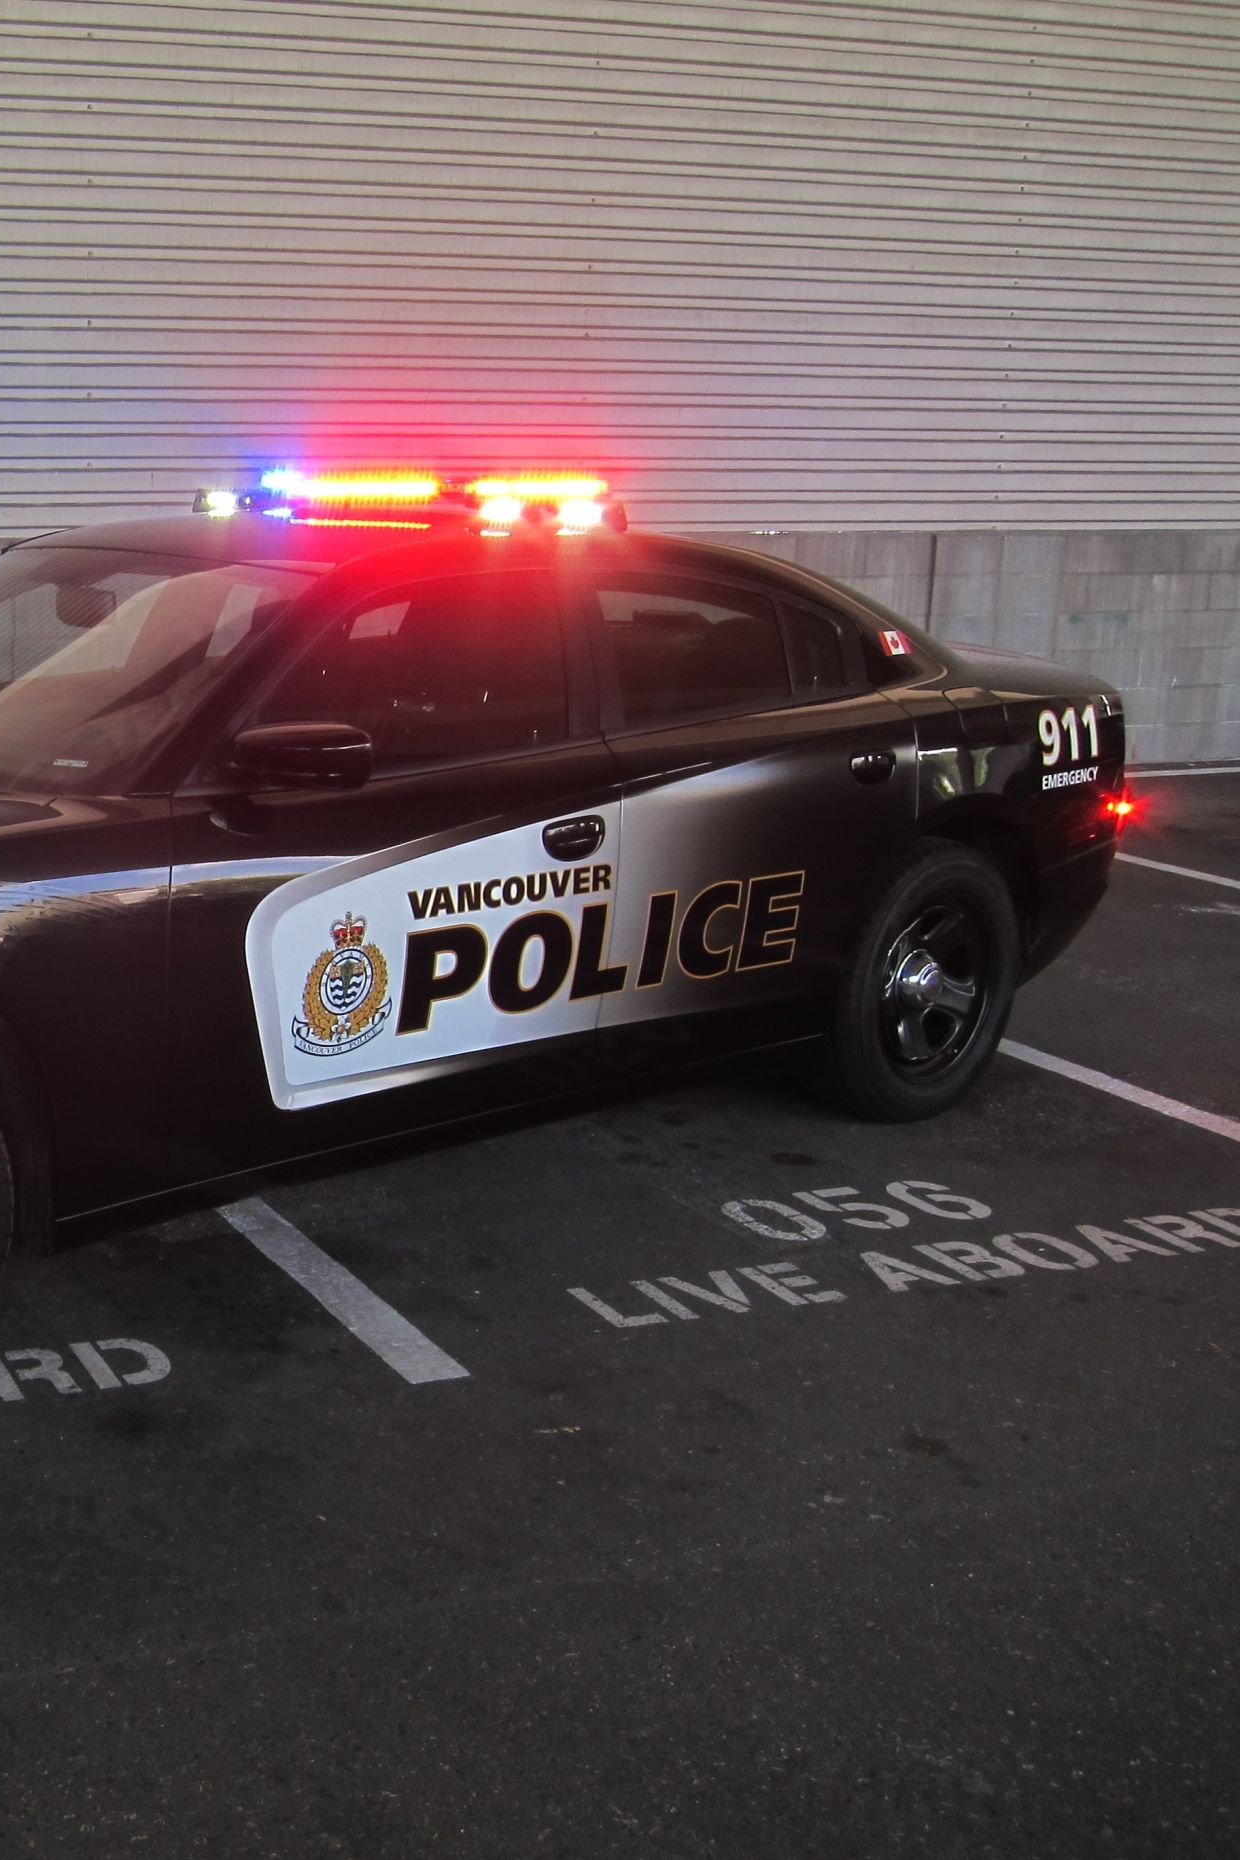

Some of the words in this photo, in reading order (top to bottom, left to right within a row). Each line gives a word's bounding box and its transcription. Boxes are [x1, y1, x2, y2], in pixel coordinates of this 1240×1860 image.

[1037, 704, 1100, 767] 911
[1041, 766, 1099, 791] EMERGENCY
[406, 864, 612, 921] VANCOUVER
[395, 869, 806, 1037] POLICE
[720, 1180, 993, 1242] 056
[567, 1261, 848, 1328] LIVE
